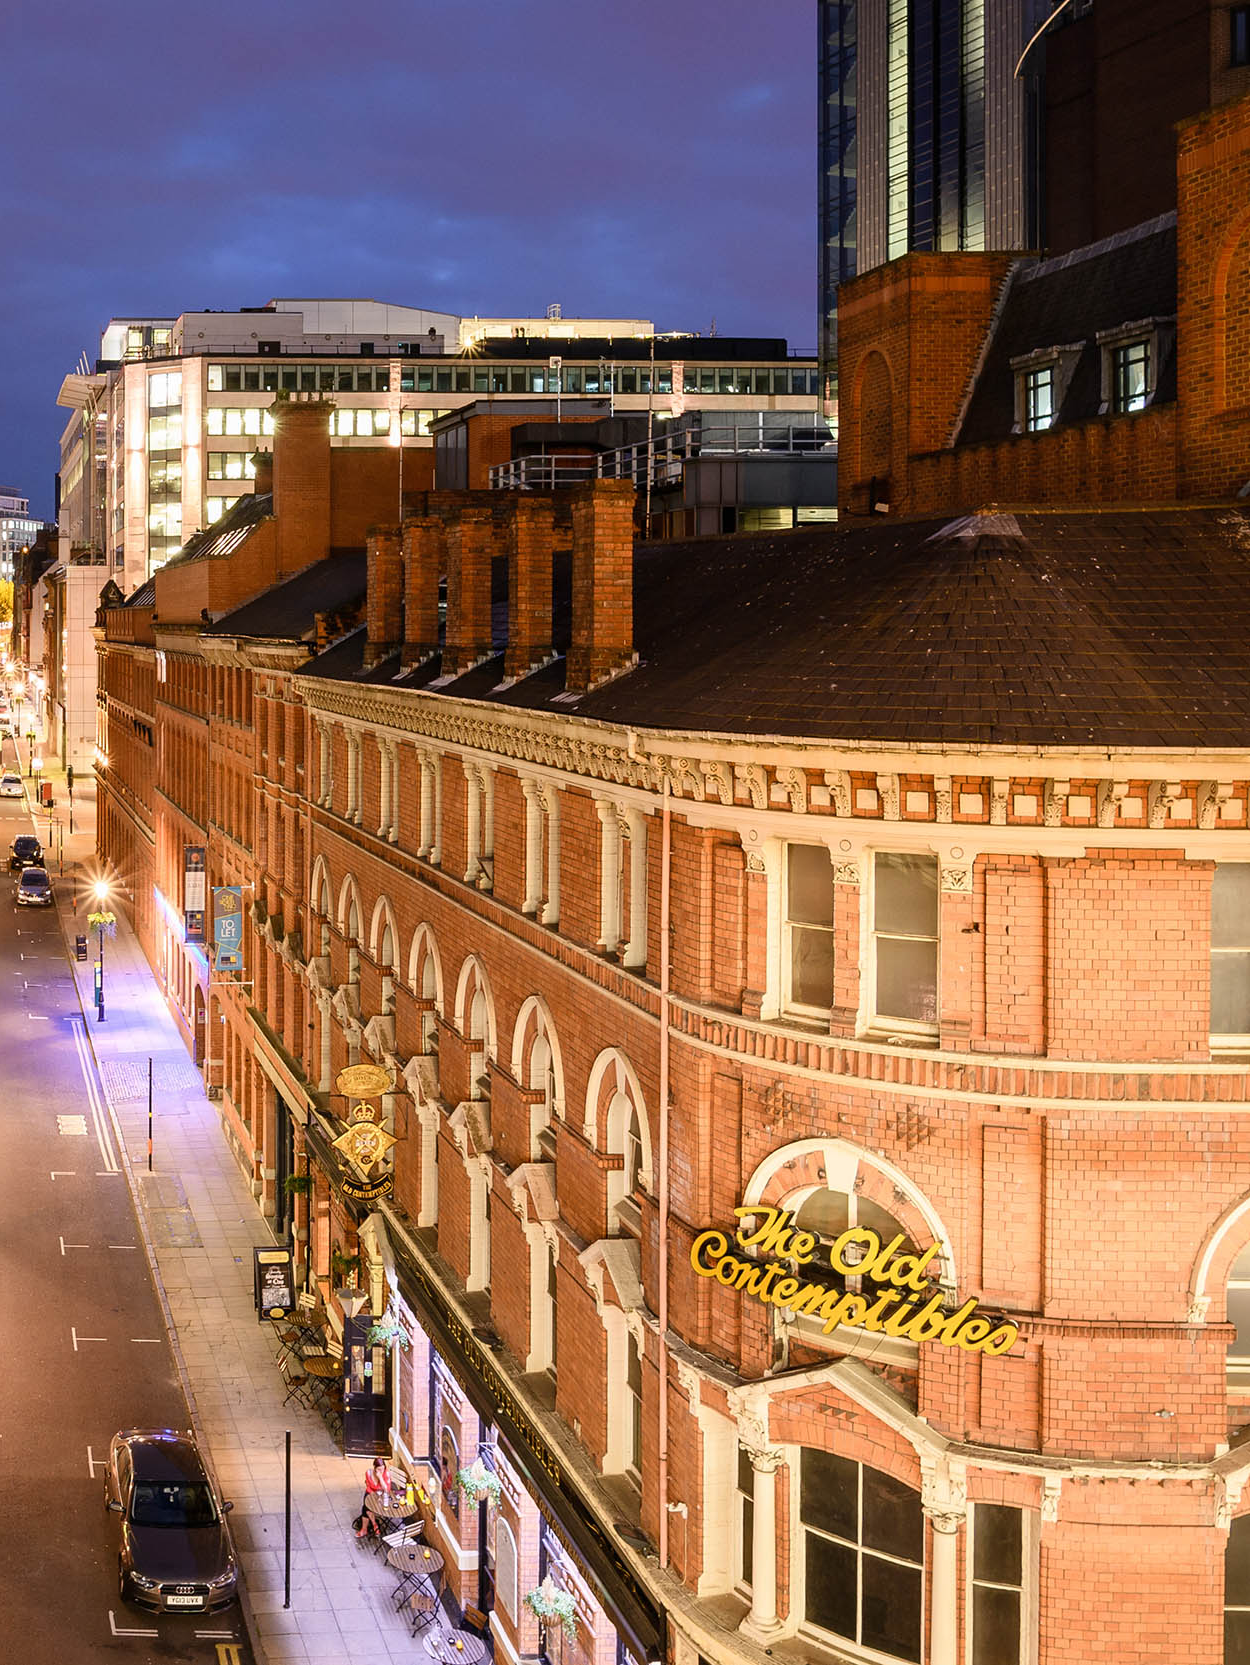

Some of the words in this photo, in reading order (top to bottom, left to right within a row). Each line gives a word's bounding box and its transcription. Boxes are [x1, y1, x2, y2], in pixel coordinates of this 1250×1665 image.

[221, 919, 235, 929] TO
[221, 928, 236, 938] LET
[342, 1184, 353, 1196] OLD
[733, 1206, 816, 1265] The
[829, 1227, 943, 1291] Old
[690, 1230, 1019, 1356] Contemptibles
[447, 1311, 462, 1345] THE
[464, 1337, 481, 1371] OLD
[483, 1360, 560, 1487] CONTEMPTIBLES
